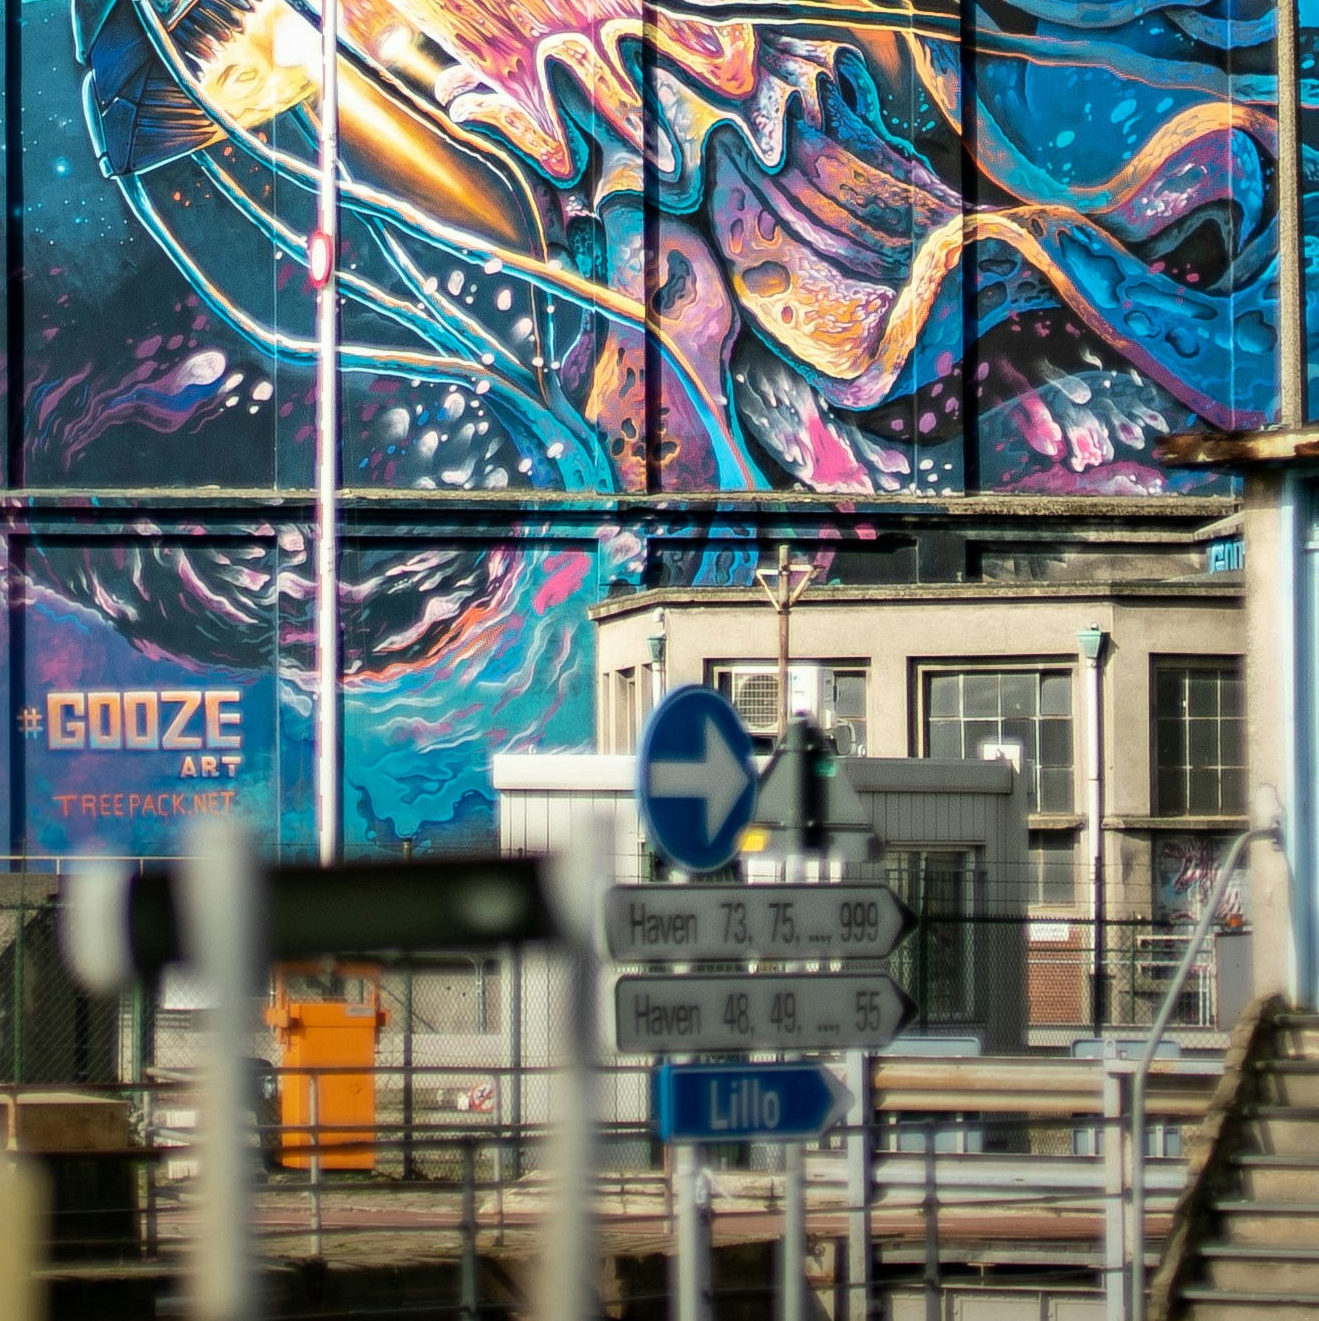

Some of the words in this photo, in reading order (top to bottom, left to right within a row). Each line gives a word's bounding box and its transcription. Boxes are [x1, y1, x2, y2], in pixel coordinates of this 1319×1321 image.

[181, 756, 241, 777] ART
[53, 791, 235, 819] TREEPACK.NET
[630, 902, 698, 945] Haven
[721, 903, 753, 945] 73,
[768, 903, 801, 946] 75,
[840, 902, 879, 943] 999
[634, 994, 701, 1036] Haven
[723, 993, 755, 1037] 48,
[770, 993, 802, 1034] 49,
[855, 991, 880, 1033] 55
[711, 1079, 780, 1129] Lillo
